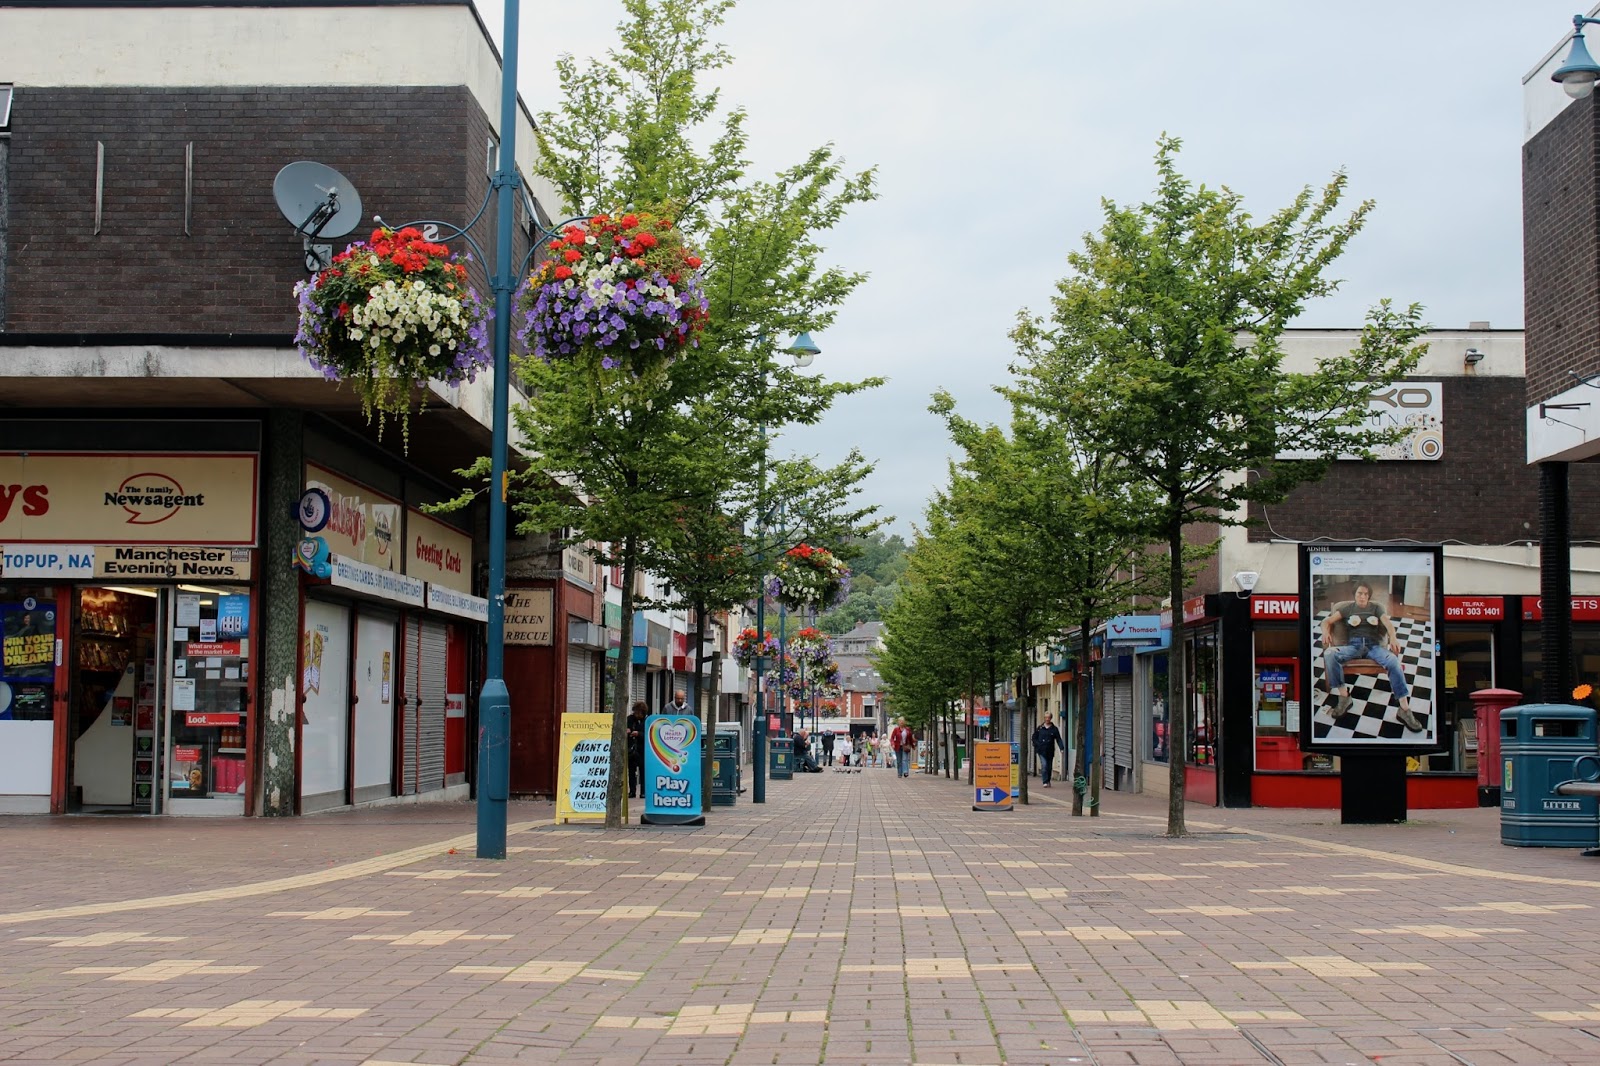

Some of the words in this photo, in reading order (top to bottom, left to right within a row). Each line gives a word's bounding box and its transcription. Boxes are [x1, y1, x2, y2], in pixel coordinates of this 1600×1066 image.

[125, 486, 141, 494] The
[145, 486, 174, 494] family
[103, 492, 205, 508] Newsagent
[115, 548, 225, 562] Manchester
[416, 535, 443, 571] Greeting
[445, 548, 462, 574] Cards
[3, 554, 63, 571] TOPUP,
[104, 562, 177, 577] Evening
[181, 562, 235, 576] News
[507, 593, 531, 608] THE
[1447, 607, 1464, 616] 0161
[1466, 607, 1482, 616] 303
[1483, 607, 1500, 616] 1401
[503, 614, 545, 624] HICKEN
[3, 636, 25, 647] WIN
[25, 633, 55, 645] YOUR
[505, 631, 549, 641] RBECUE
[3, 642, 55, 656] WILDEST
[3, 652, 54, 666] DREAMS
[188, 715, 207, 724] Loot
[593, 721, 612, 729] New
[574, 743, 602, 752] GIANT
[571, 755, 590, 764] AND
[587, 767, 607, 776] NEW
[579, 779, 608, 788] SEASO
[656, 776, 688, 793] Play
[574, 791, 606, 801] PULL-O
[653, 793, 692, 808] here!
[1543, 801, 1580, 809] LITTER
